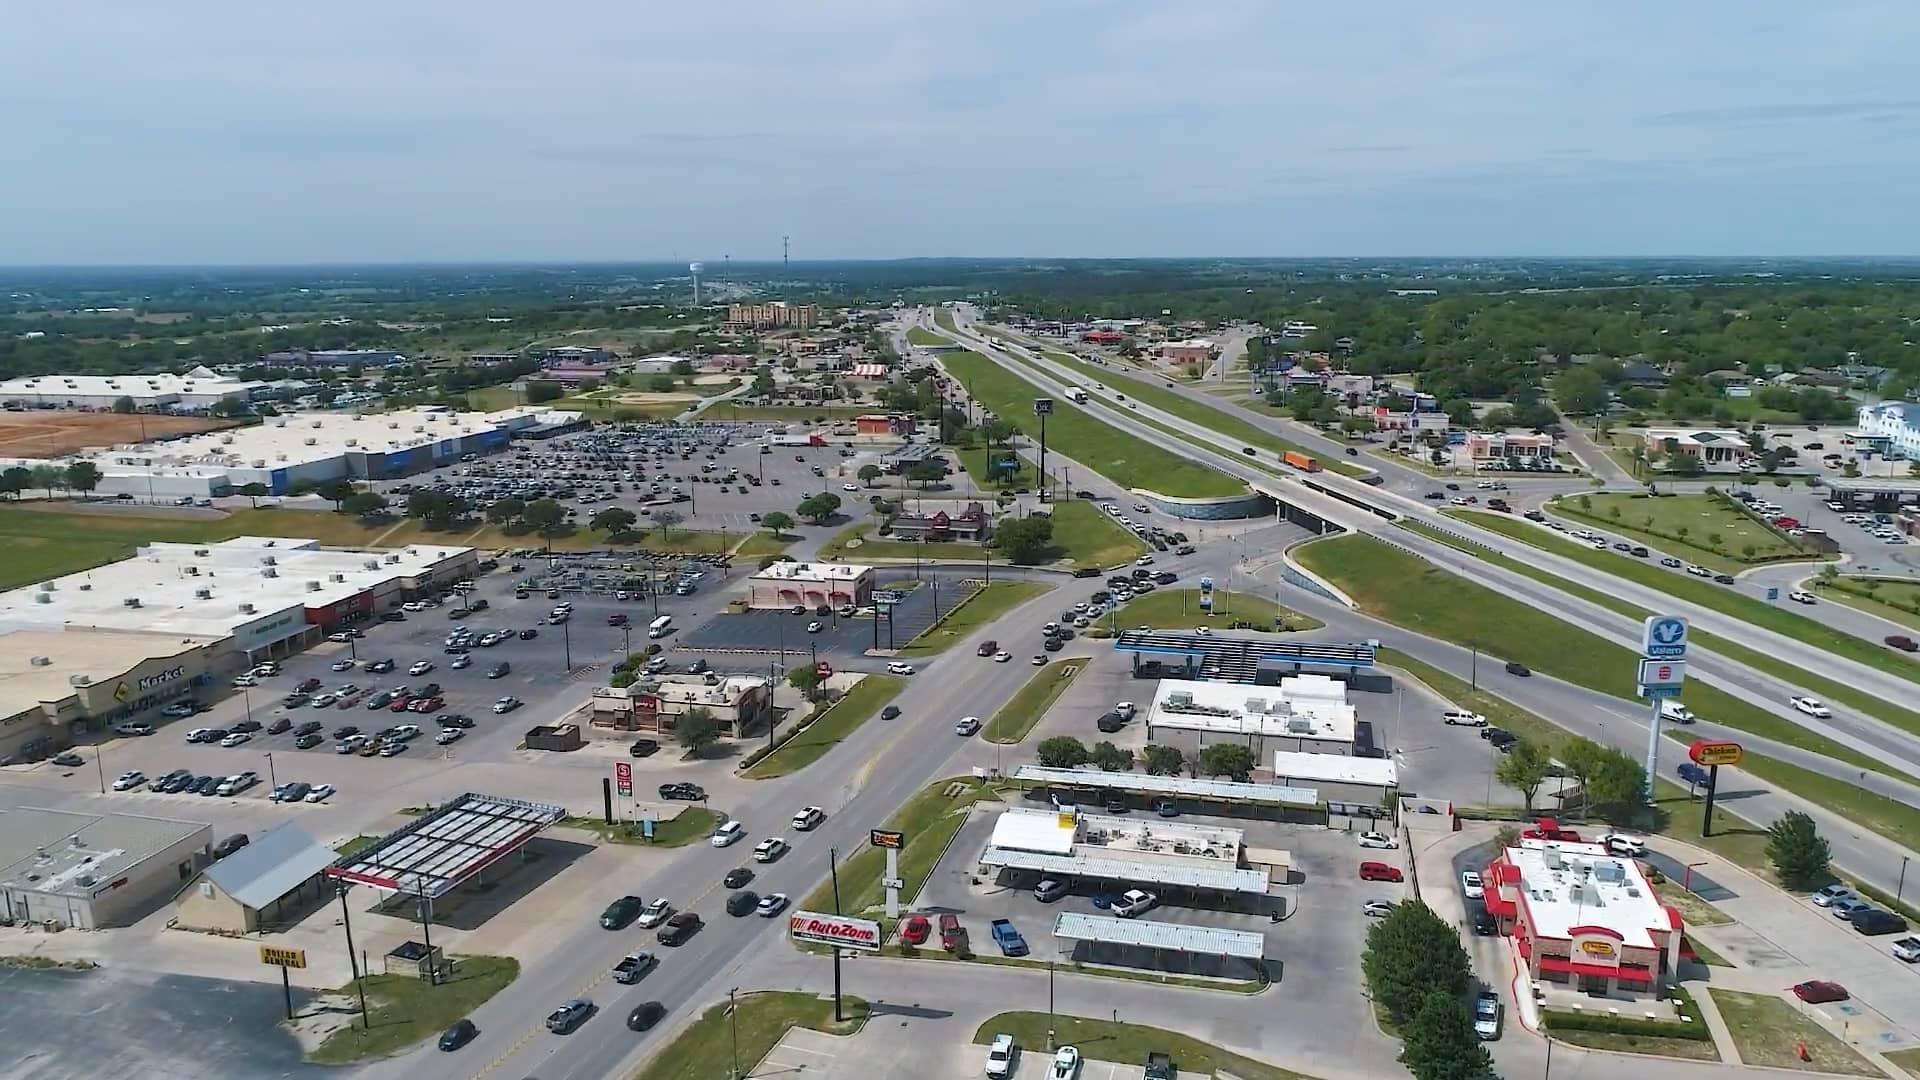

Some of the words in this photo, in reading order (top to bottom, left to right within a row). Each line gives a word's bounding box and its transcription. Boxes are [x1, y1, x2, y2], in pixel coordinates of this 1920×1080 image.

[139, 665, 185, 691] Market
[807, 920, 874, 940] AutoZone
[264, 956, 301, 968] GENERAL
